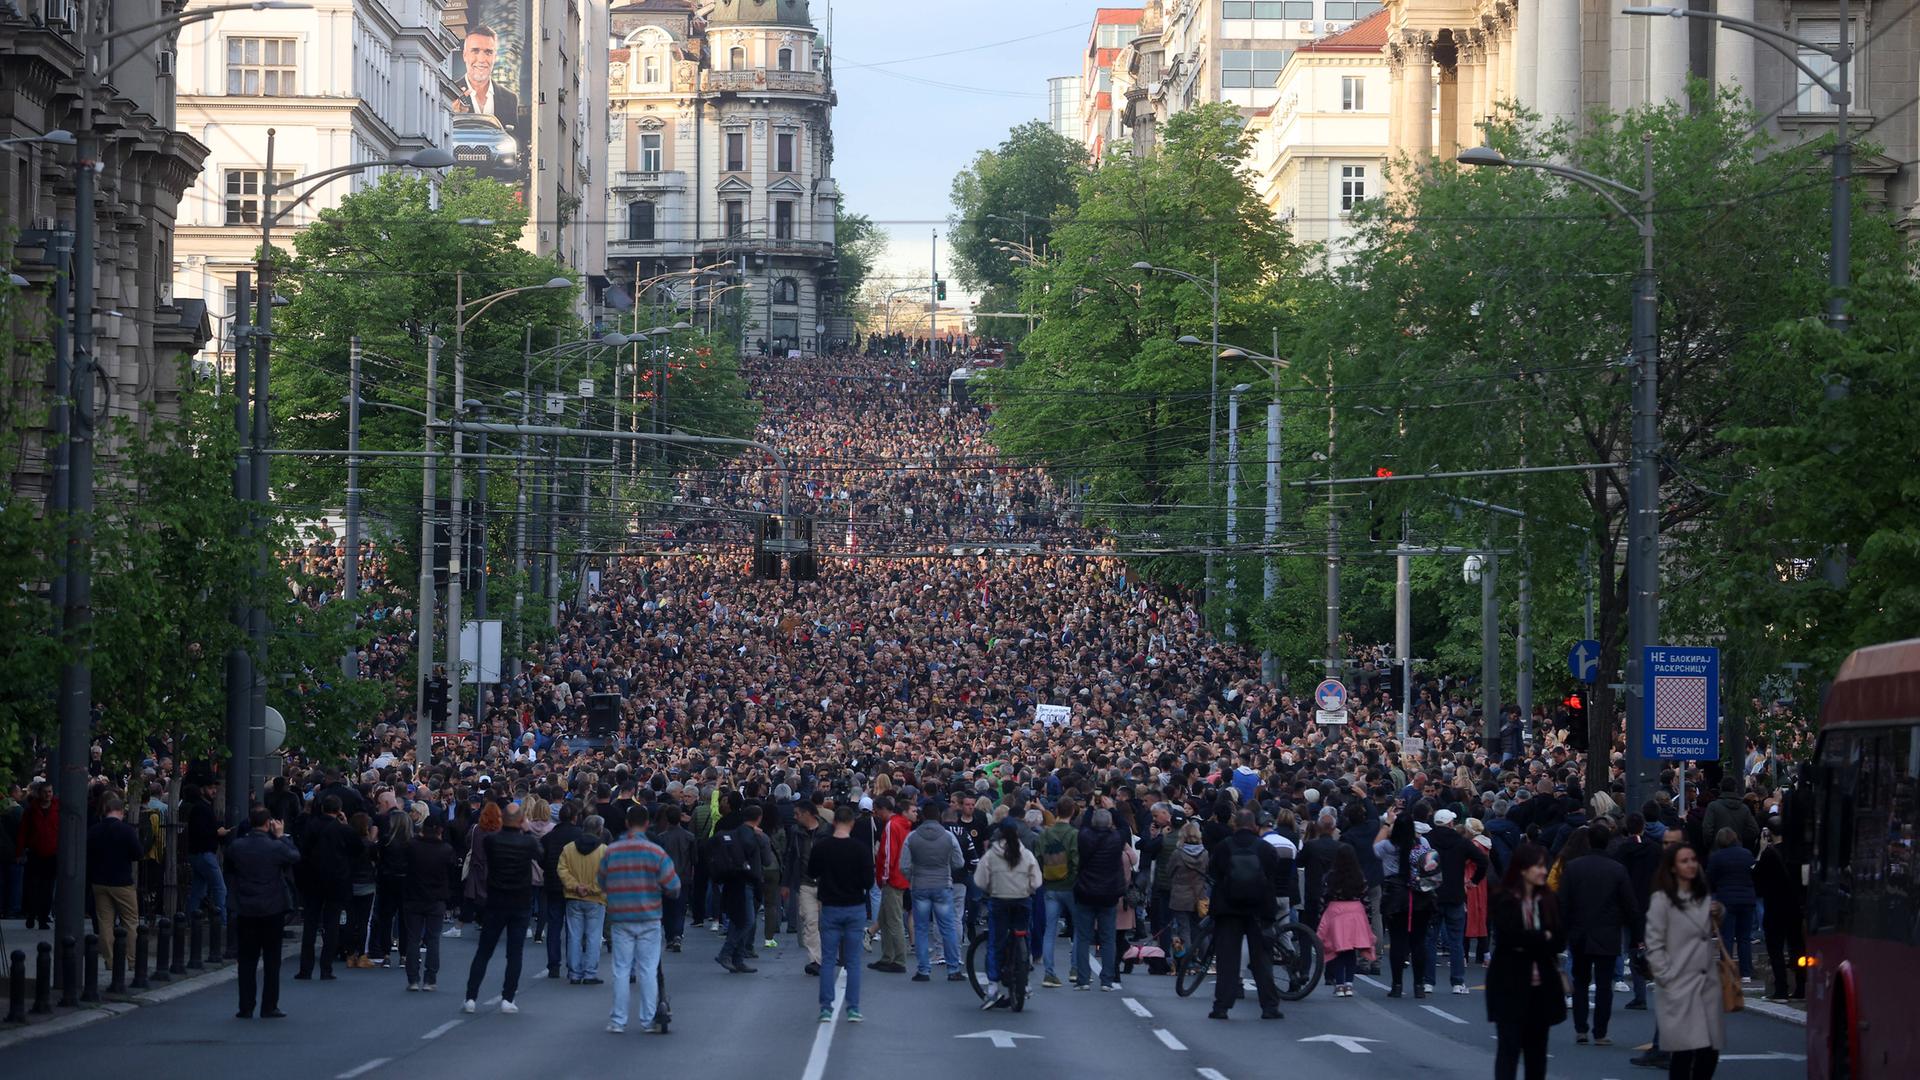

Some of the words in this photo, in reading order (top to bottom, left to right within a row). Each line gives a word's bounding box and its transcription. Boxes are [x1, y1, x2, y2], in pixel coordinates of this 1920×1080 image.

[1651, 652, 1666, 662] НЕ
[1670, 655, 1711, 663] БЛОКИРАЈ
[1655, 664, 1707, 673] РАСКРСНИЦУ
[1652, 734, 1667, 744] NE
[1671, 737, 1709, 745] BLOKIRAJ
[1656, 746, 1705, 755] RASKRSNICU
